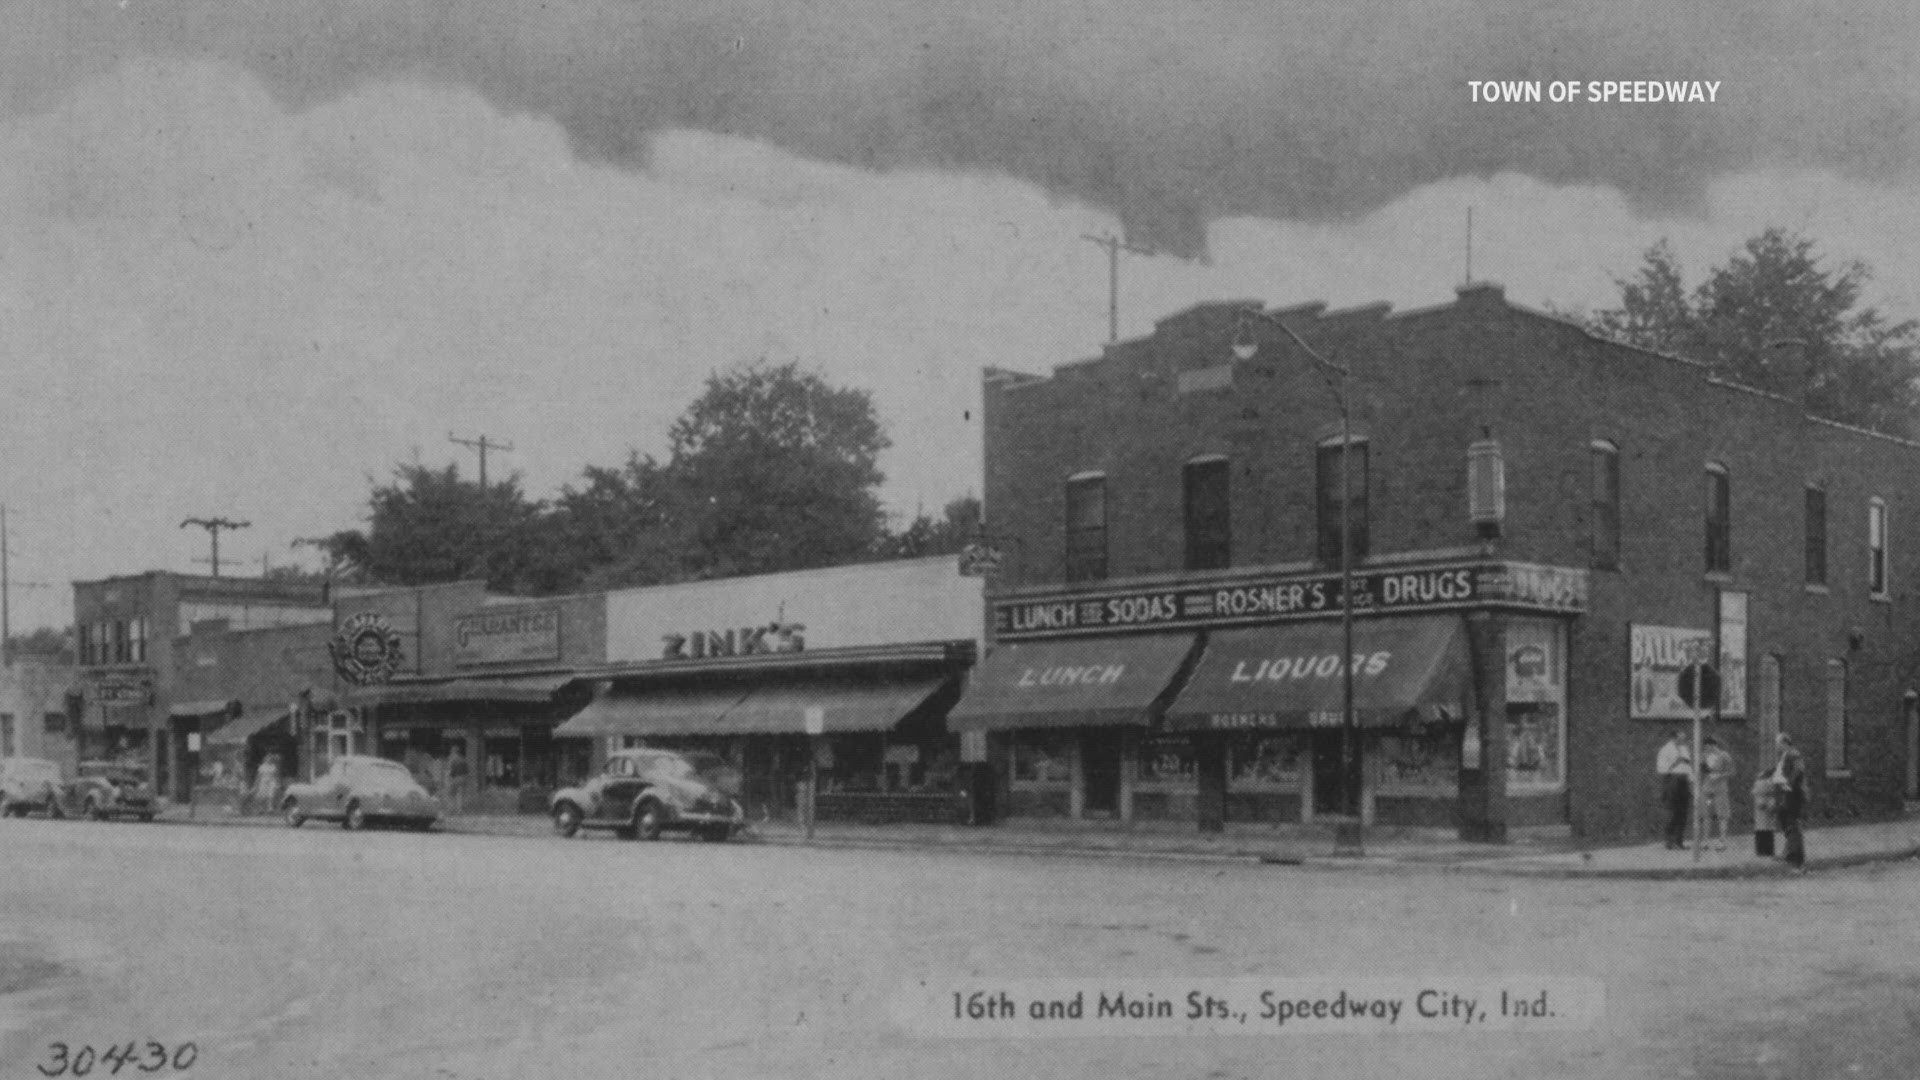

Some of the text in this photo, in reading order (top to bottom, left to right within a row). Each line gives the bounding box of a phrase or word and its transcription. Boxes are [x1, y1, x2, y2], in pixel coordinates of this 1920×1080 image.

[1012, 602, 1077, 630] LUNCH
[1107, 594, 1177, 624] SODAS
[1215, 582, 1326, 616] ROSNER'S
[1383, 570, 1472, 604] DRUGS
[661, 622, 807, 660] ZINK'S
[1017, 663, 1126, 688] LUNCH
